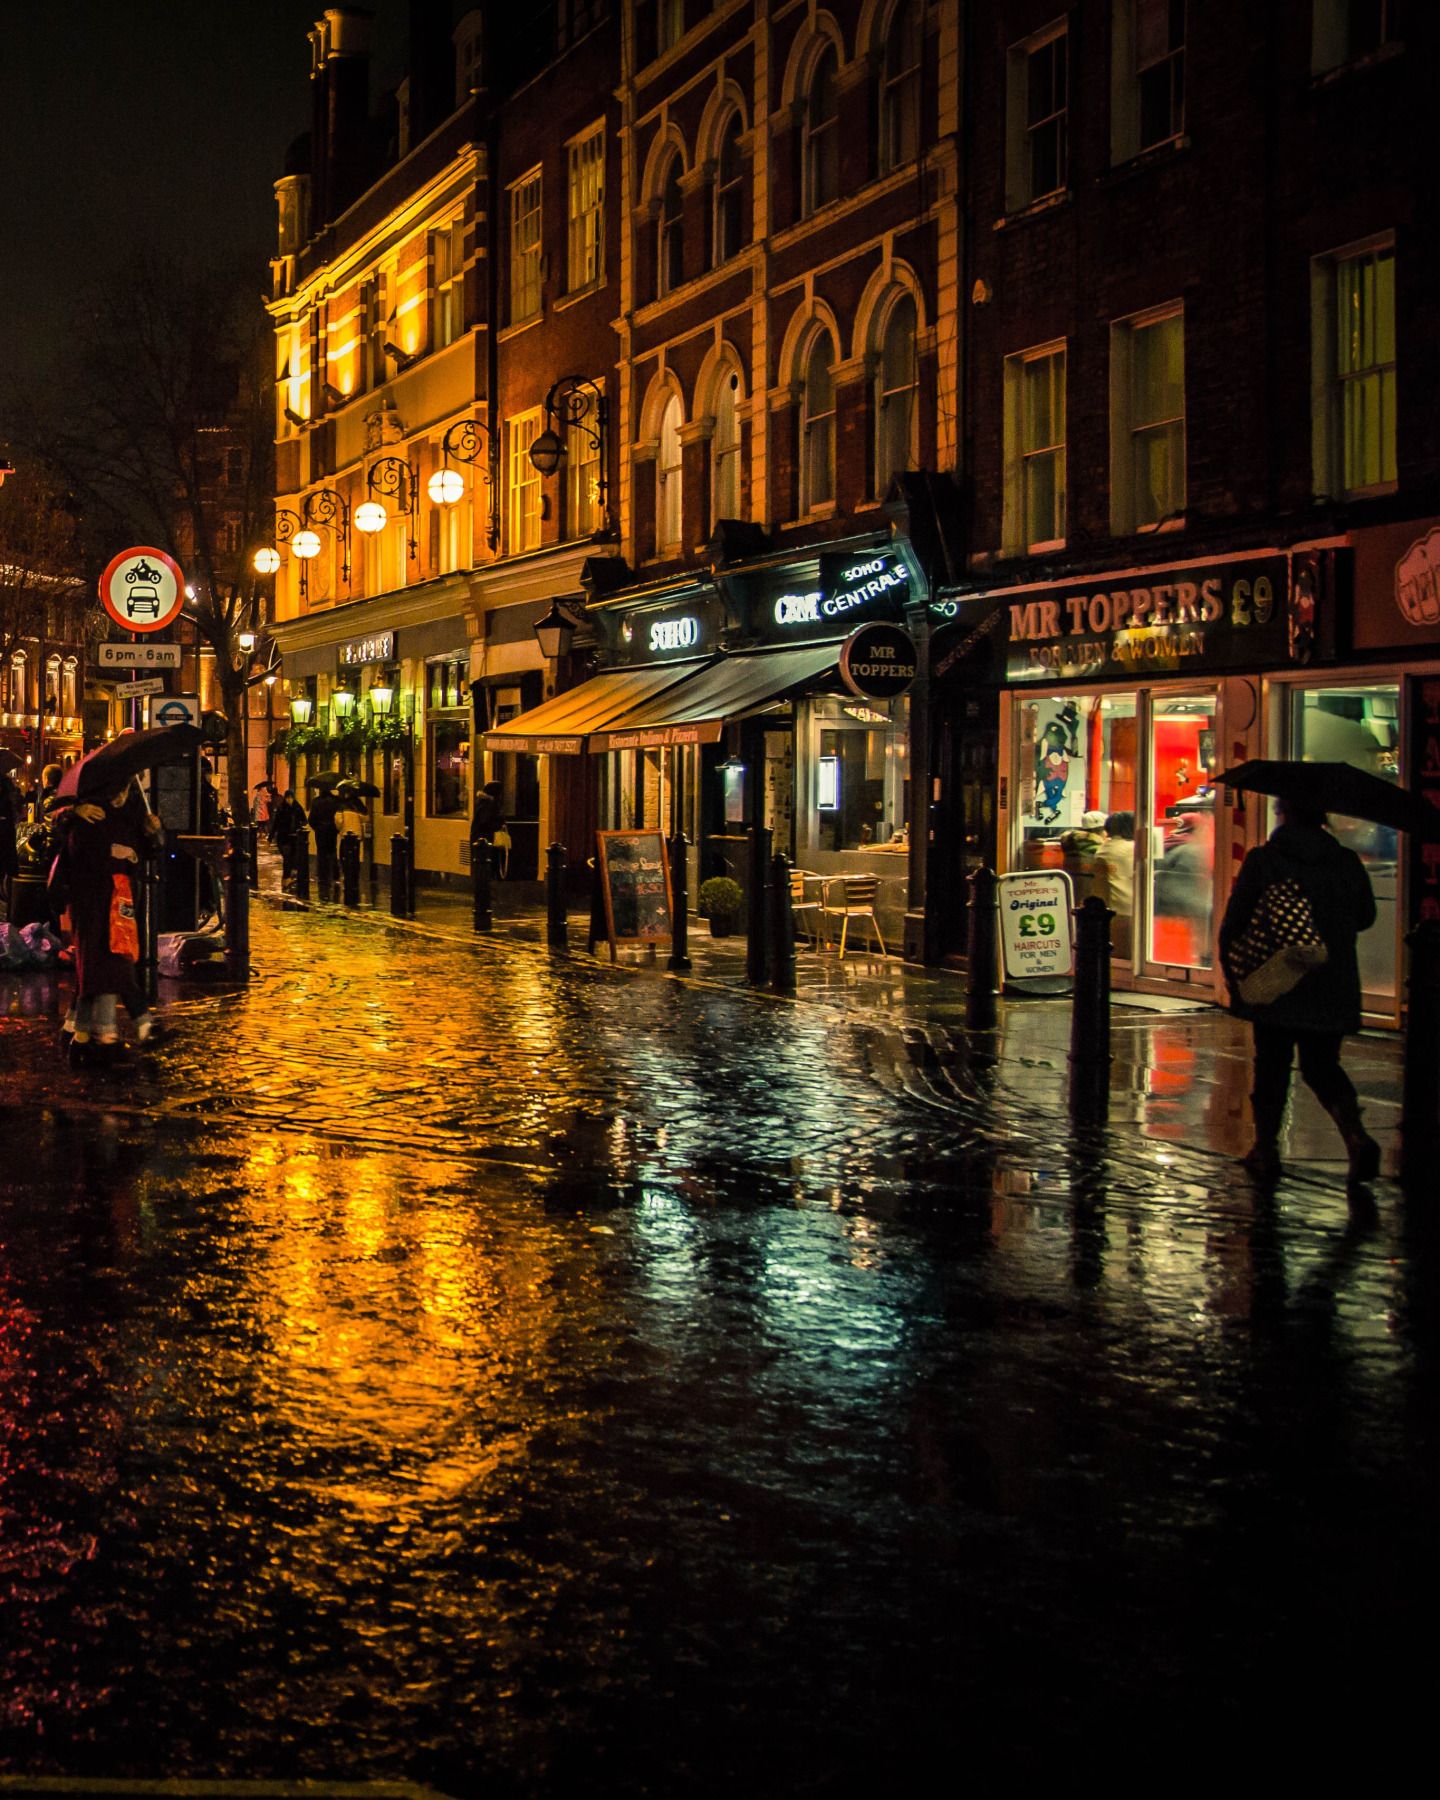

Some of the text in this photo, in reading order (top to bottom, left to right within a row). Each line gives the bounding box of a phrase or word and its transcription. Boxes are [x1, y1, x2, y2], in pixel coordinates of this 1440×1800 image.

[844, 560, 885, 582] SOHO
[822, 564, 909, 616] CENTRALE
[1008, 576, 1274, 642] MR TOPPERS £9
[869, 646, 896, 660] MR
[1029, 632, 1206, 668] FOR MEN & WOMEN
[851, 664, 915, 678] TOPPERS
[1007, 887, 1059, 897] TOPPER'S
[1009, 897, 1058, 911] Original
[1018, 912, 1056, 937] £9
[1014, 939, 1061, 951] HAIRCUTS
[1020, 949, 1057, 959] FOR MEN
[1025, 965, 1055, 974] WOMEN
